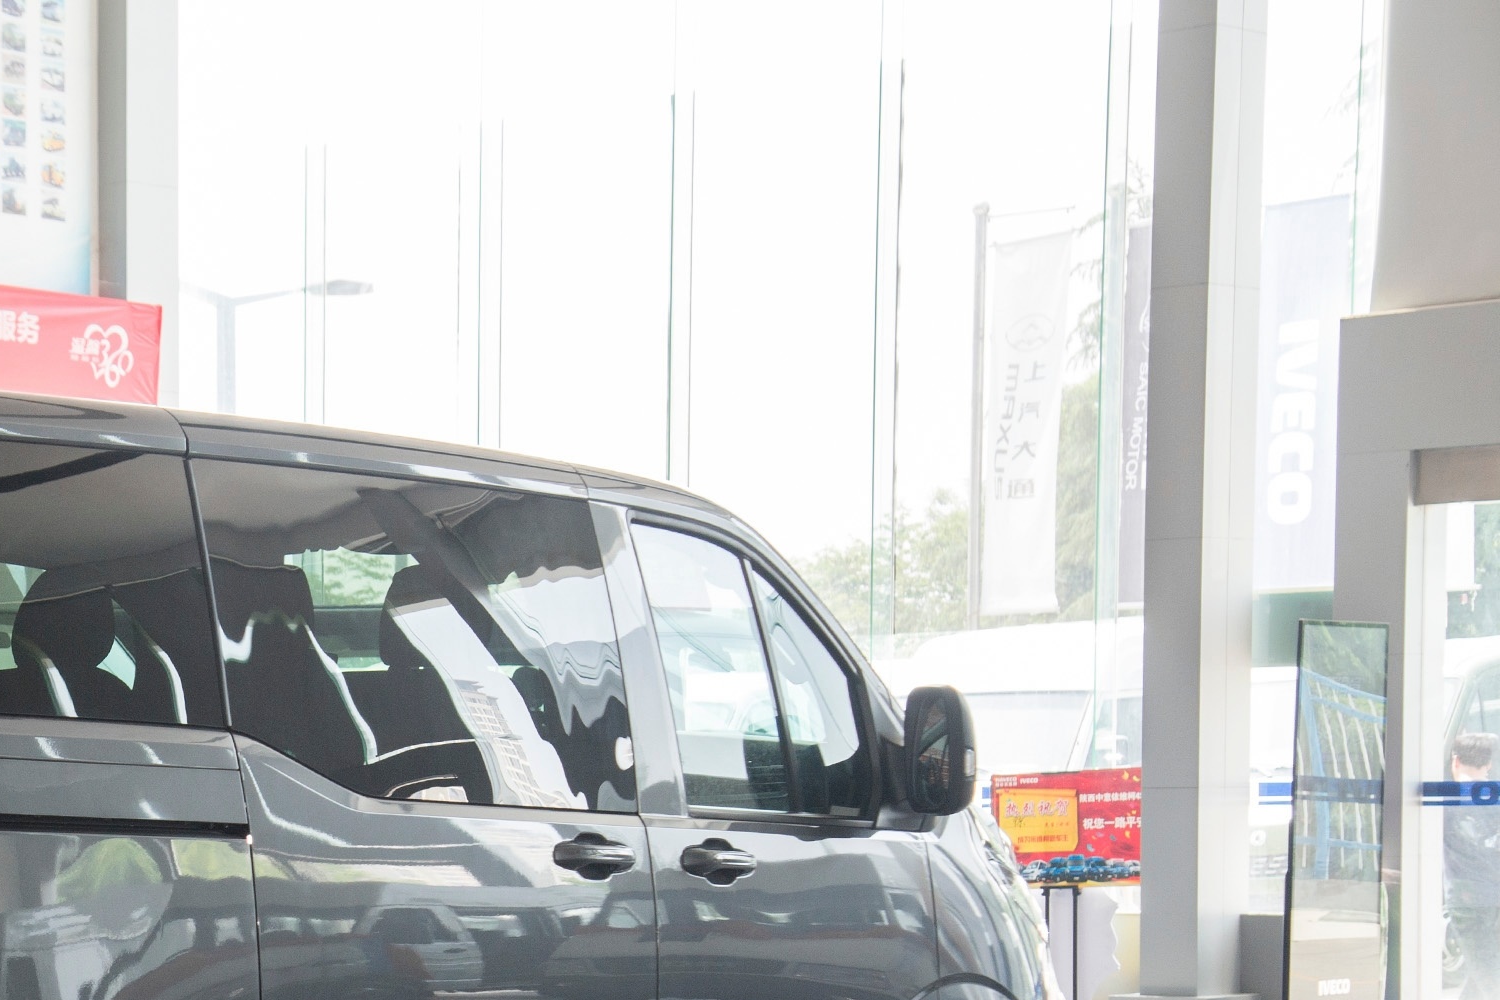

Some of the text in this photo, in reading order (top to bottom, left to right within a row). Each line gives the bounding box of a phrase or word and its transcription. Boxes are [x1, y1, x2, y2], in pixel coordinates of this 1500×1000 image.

[1267, 319, 1320, 525] IVECO
[1125, 416, 1145, 490] MOTOR
[1079, 792, 1141, 802] 陕西中意依维柯4
[1318, 979, 1350, 996] IVECO
